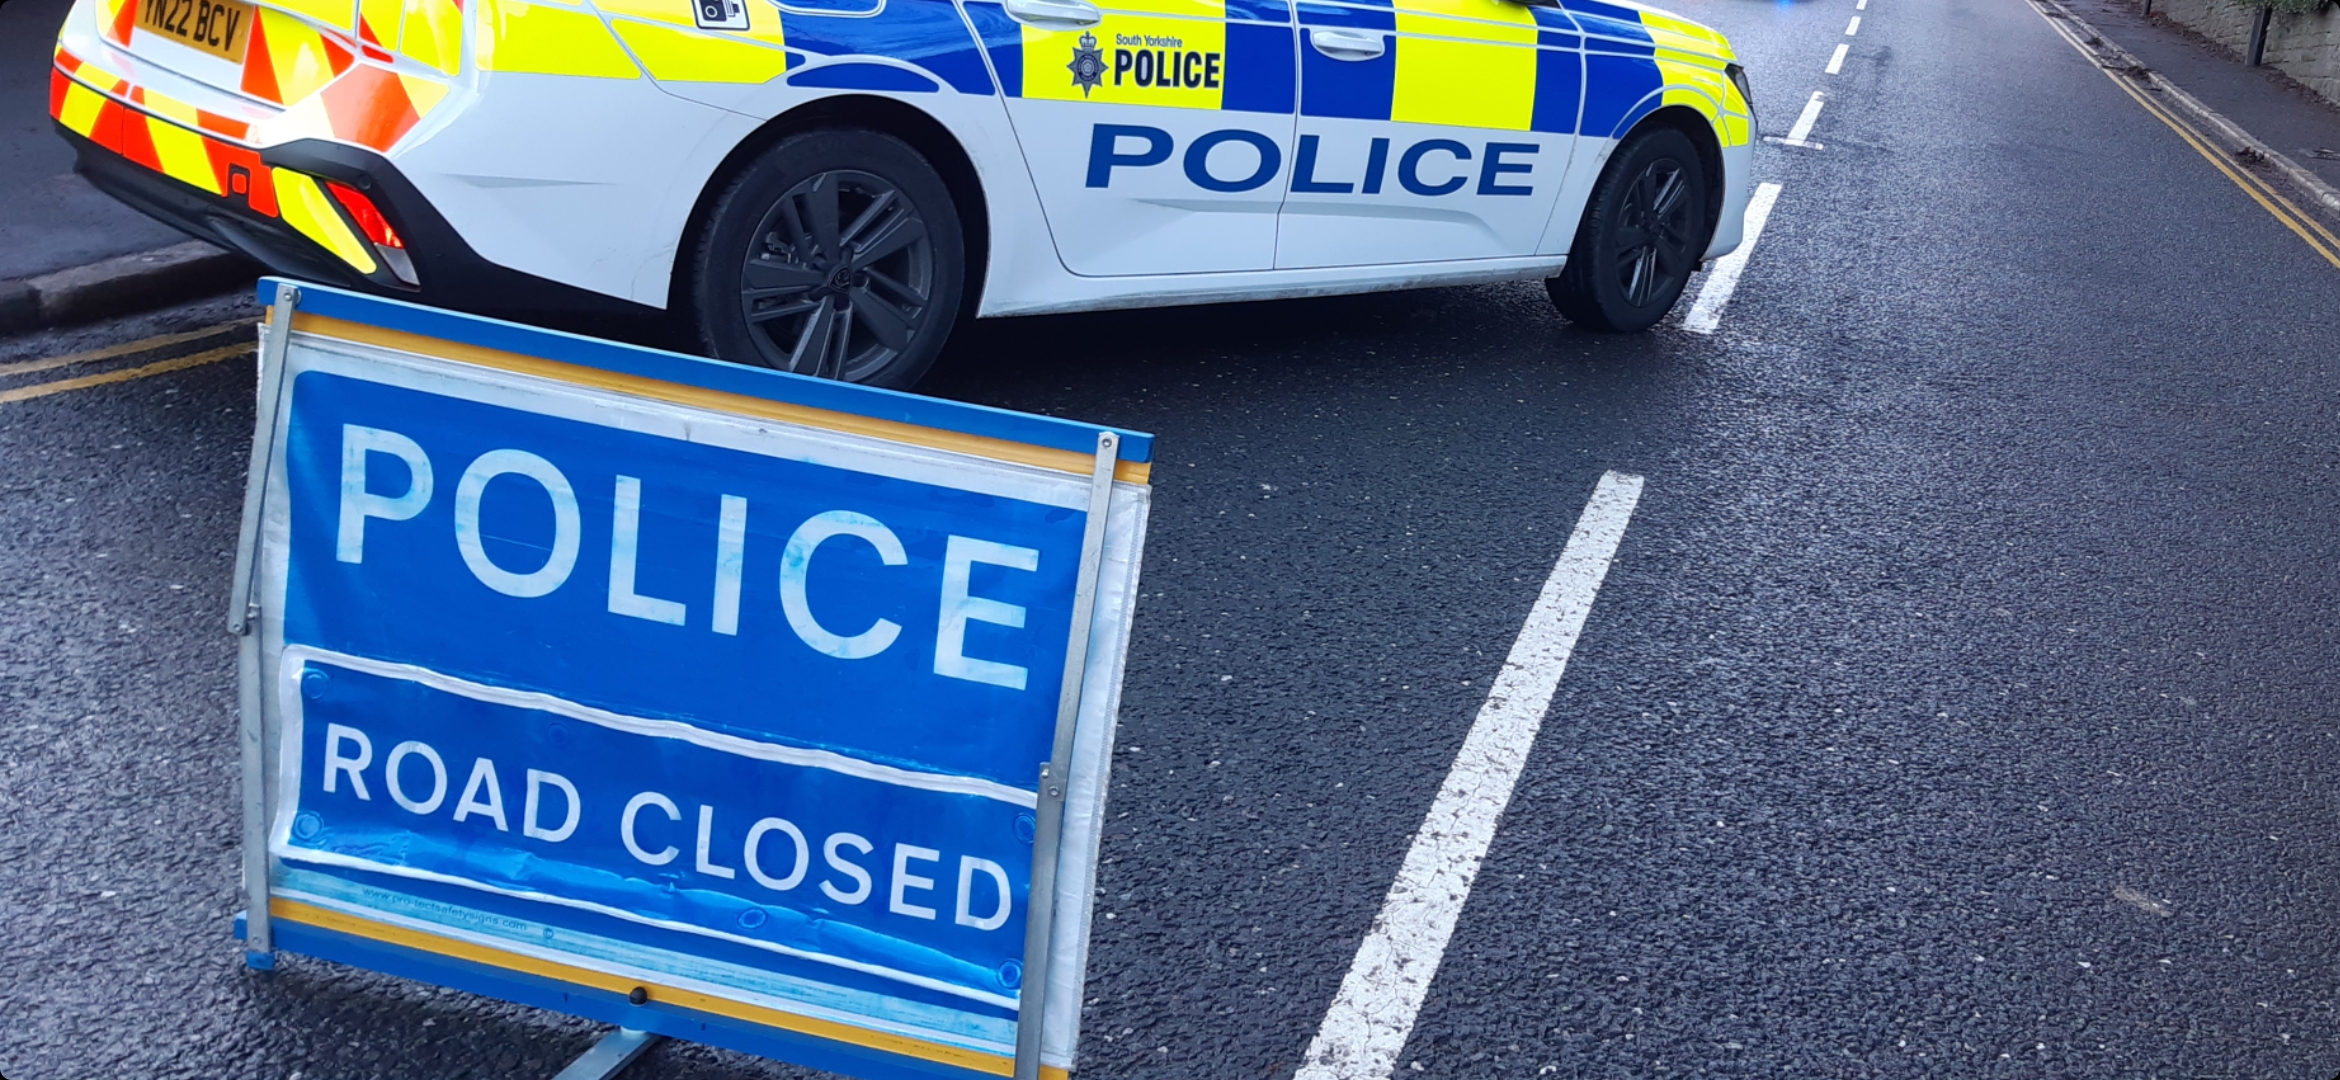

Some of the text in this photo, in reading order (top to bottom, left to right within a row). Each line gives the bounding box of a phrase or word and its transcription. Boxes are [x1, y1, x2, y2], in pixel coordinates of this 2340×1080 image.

[193, 0, 240, 51] BCV
[1116, 33, 1183, 48] South Yorkshire
[1114, 48, 1221, 89] POLICE
[1085, 123, 1540, 196] POLICE
[336, 423, 1039, 690] POLICE
[322, 722, 1012, 931] ROAD CLOSED
